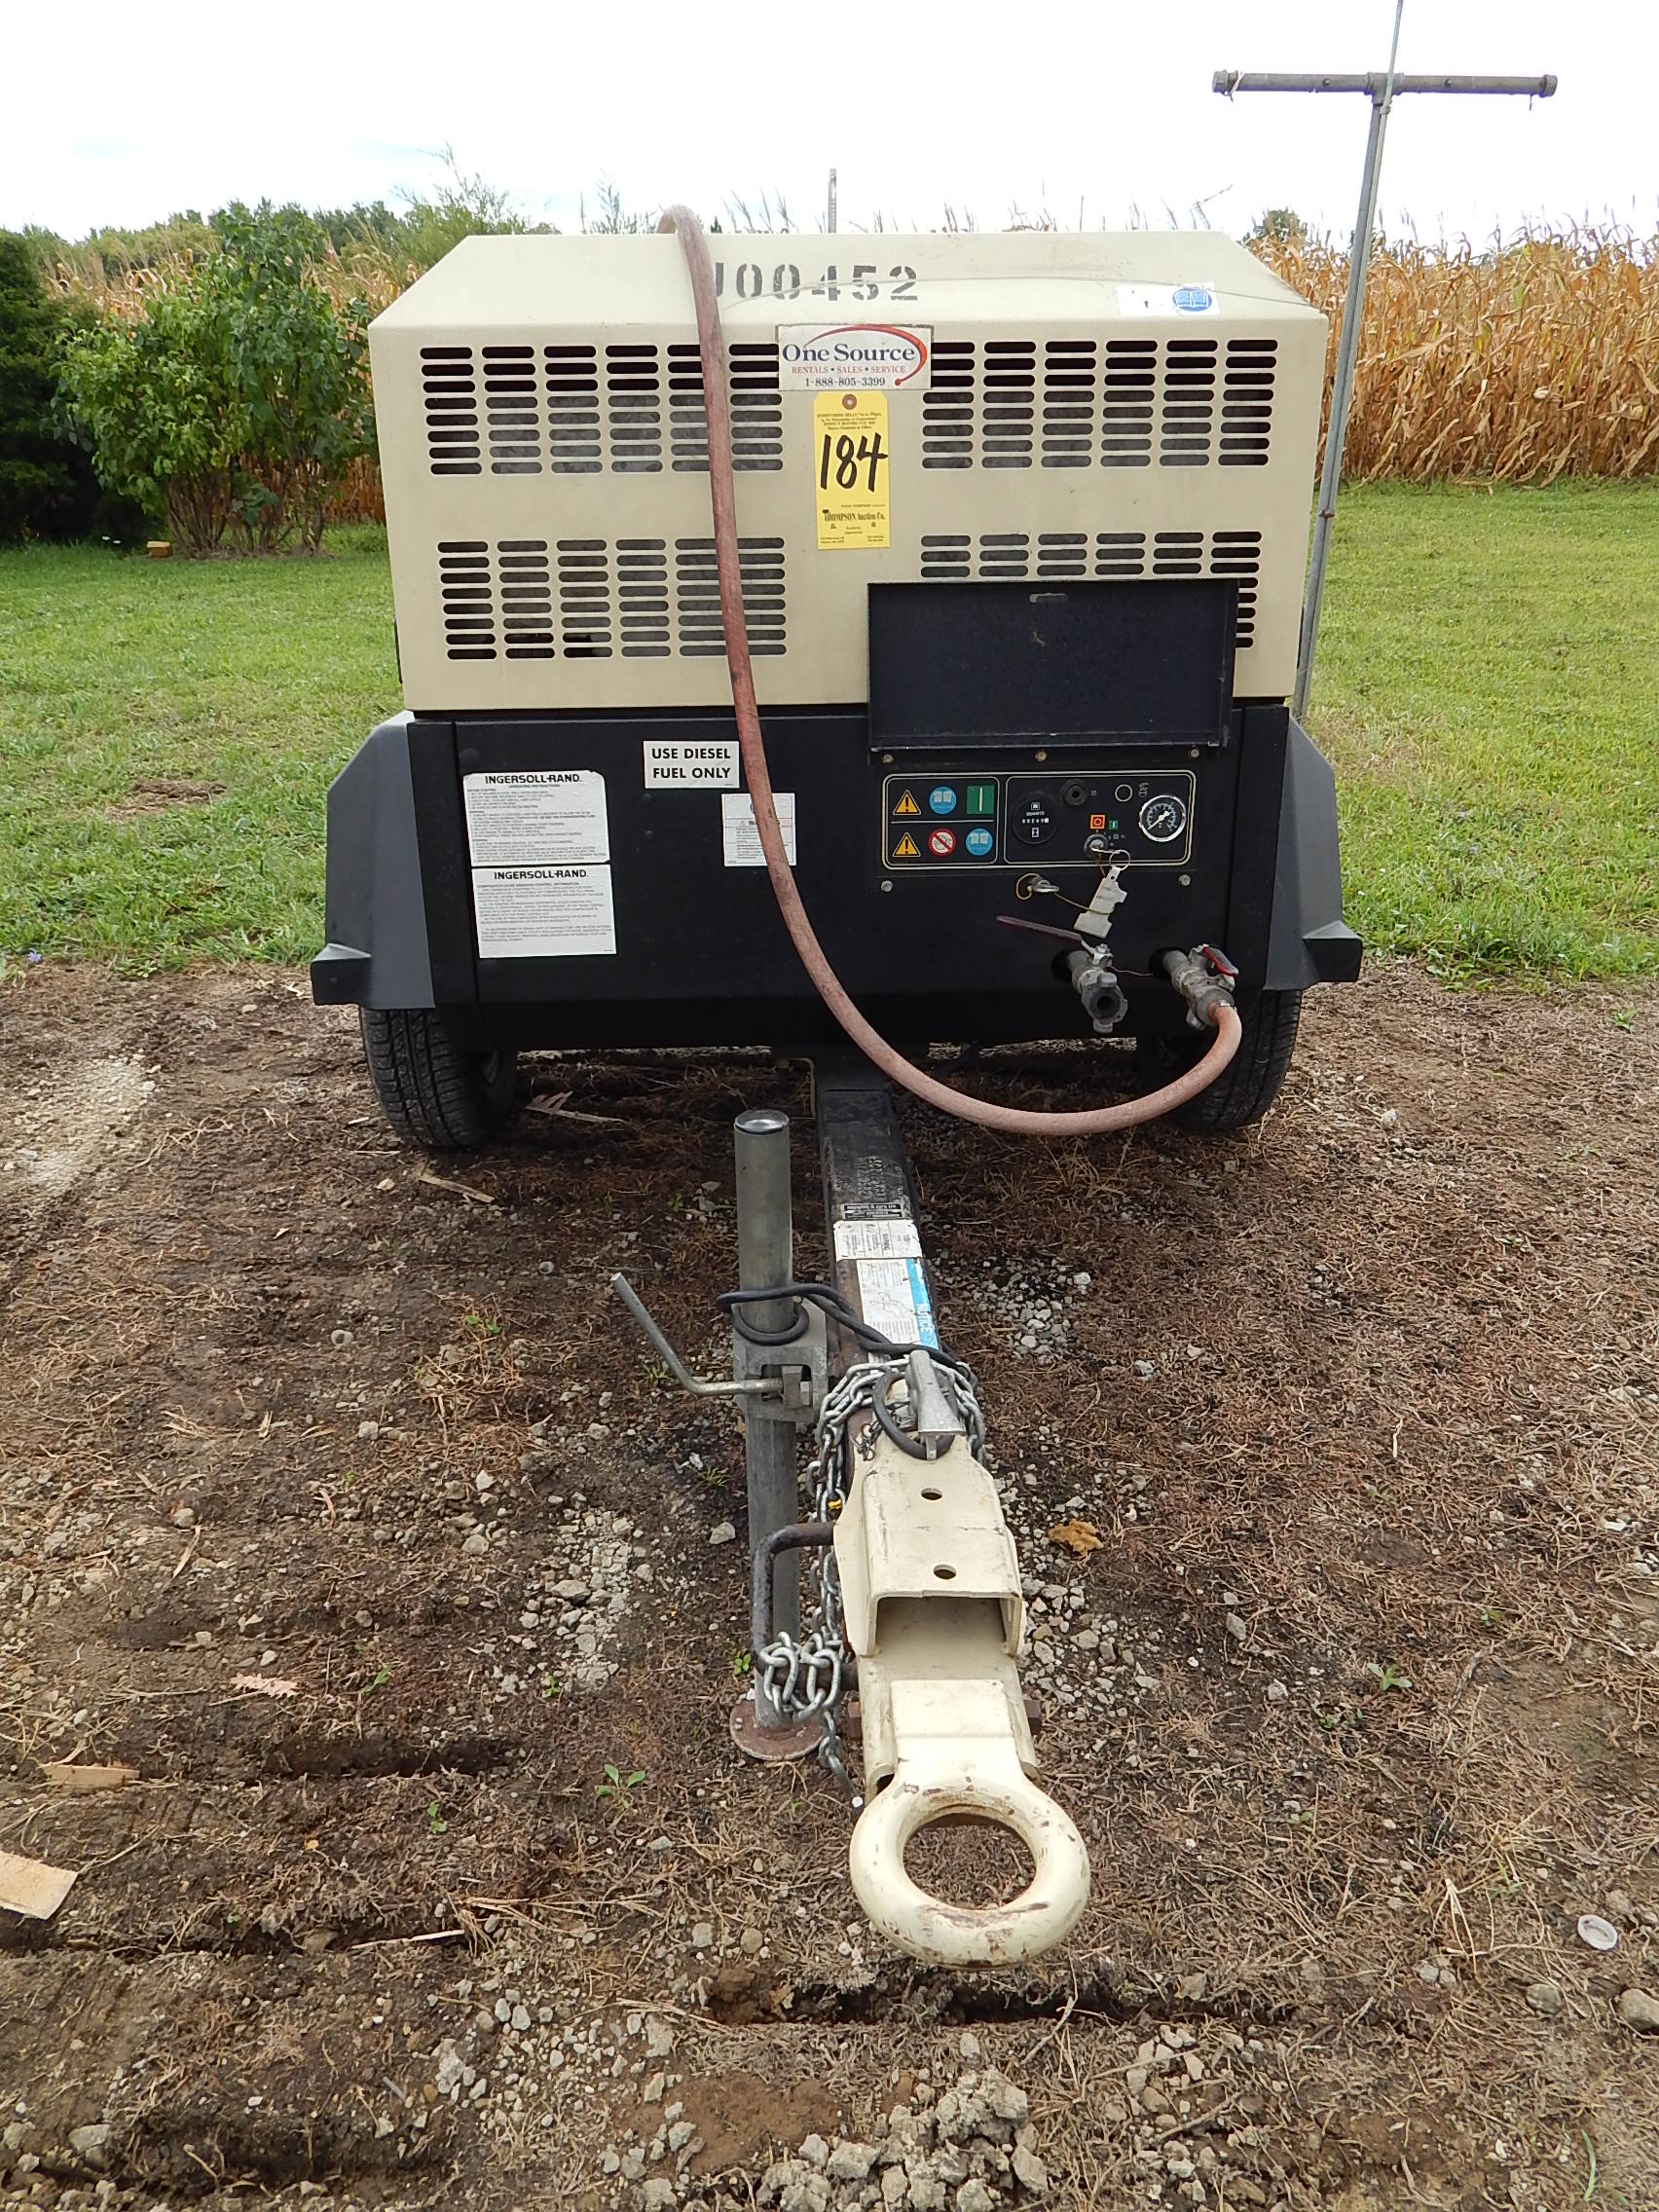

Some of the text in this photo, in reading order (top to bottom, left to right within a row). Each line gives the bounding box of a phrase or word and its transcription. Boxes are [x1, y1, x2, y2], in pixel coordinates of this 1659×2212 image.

[782, 343, 916, 363] One Source
[792, 365, 905, 375] RENTALS SALES SERVICE
[805, 376, 886, 387] 1-888-805-3399
[820, 432, 888, 493] 184
[651, 748, 731, 759] USE DIESEL
[485, 773, 581, 785] INGERSOLL-RAND
[653, 767, 731, 779] FUEL ONLY
[494, 868, 587, 880] INGERSOLL-RAND
[916, 1303, 934, 1334] NOTICE
